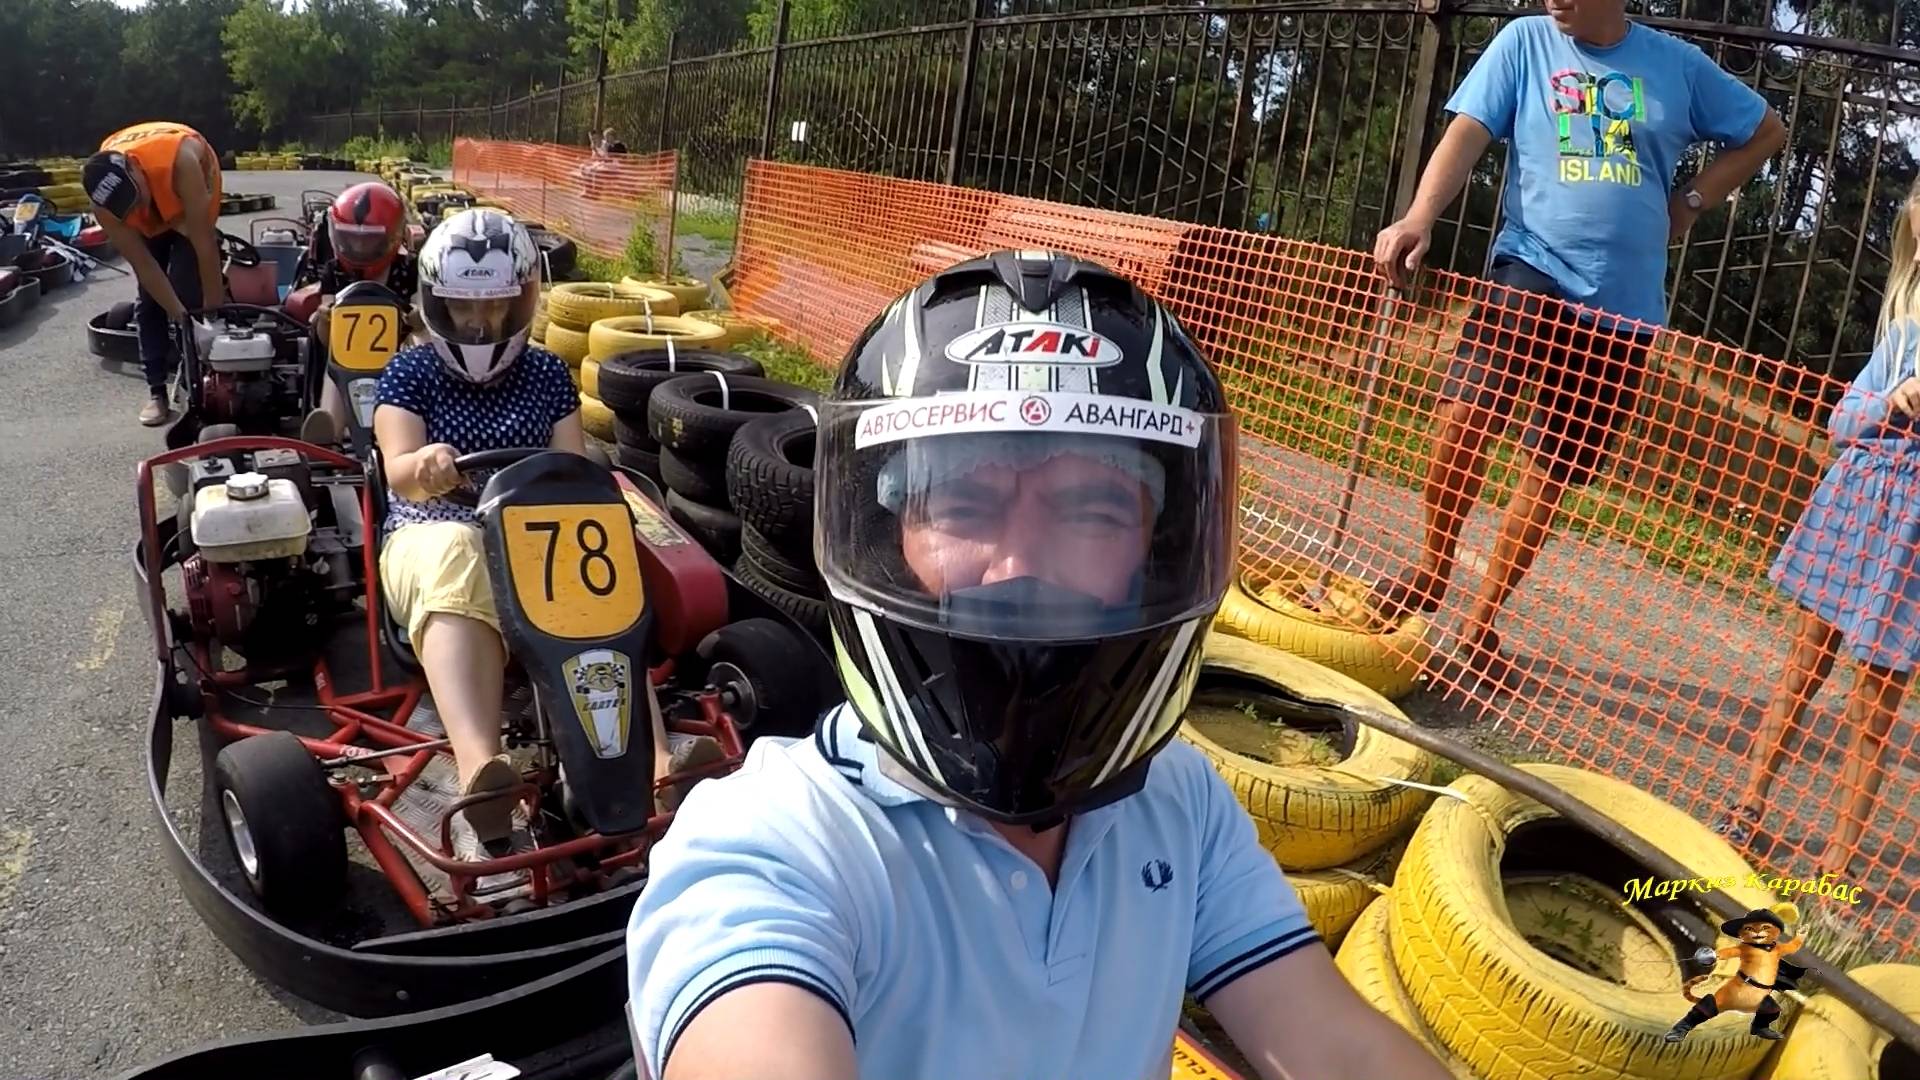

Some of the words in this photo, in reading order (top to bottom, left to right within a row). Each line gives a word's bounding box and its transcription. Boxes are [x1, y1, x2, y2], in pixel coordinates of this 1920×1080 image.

[1559, 159, 1643, 187] ISLAND
[341, 312, 389, 353] 72
[861, 400, 1008, 438] АВТОСЕРВИС
[524, 518, 618, 603] 78
[1174, 1047, 1206, 1075] CLU
